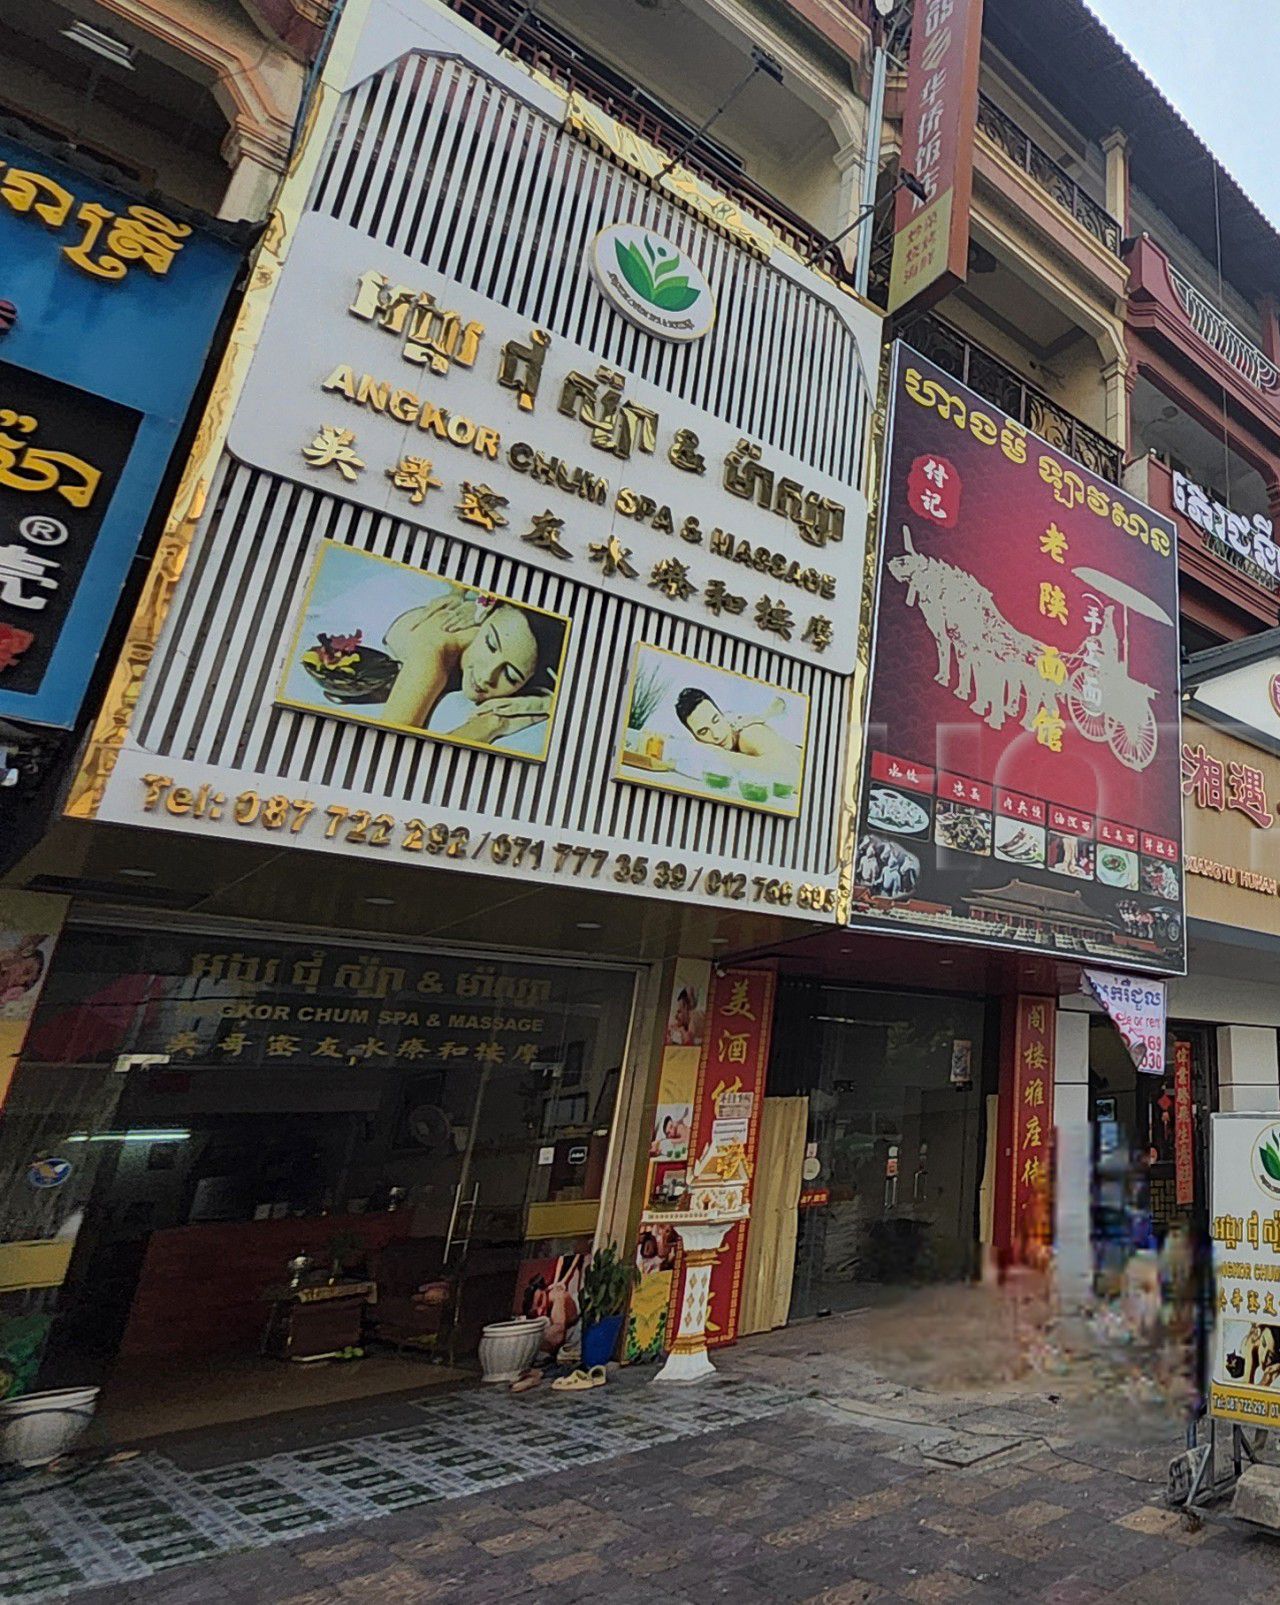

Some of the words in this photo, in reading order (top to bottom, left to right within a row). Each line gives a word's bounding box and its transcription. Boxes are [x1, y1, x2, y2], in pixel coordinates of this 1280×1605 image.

[668, 429, 706, 476] &
[321, 363, 500, 461] ANGKOR
[507, 442, 610, 505] CHUM
[615, 487, 674, 535] SPA
[680, 515, 703, 546] &
[710, 527, 837, 600] MASSAGE
[139, 773, 226, 821] Tel:
[234, 789, 316, 835] 087
[325, 803, 396, 847] 722
[553, 842, 610, 879] 777
[613, 853, 649, 885] 35
[1240, 870, 1278, 896] HUNAN
[417, 970, 443, 996] &
[297, 1006, 369, 1025] CHUM
[378, 1010, 420, 1027] SPA
[426, 1014, 440, 1028] &
[448, 1014, 544, 1033] MASSAGE
[1213, 1213, 1243, 1249] អង្គរ
[1247, 1210, 1259, 1250] ជុំ
[1254, 1263, 1280, 1282] CHUM
